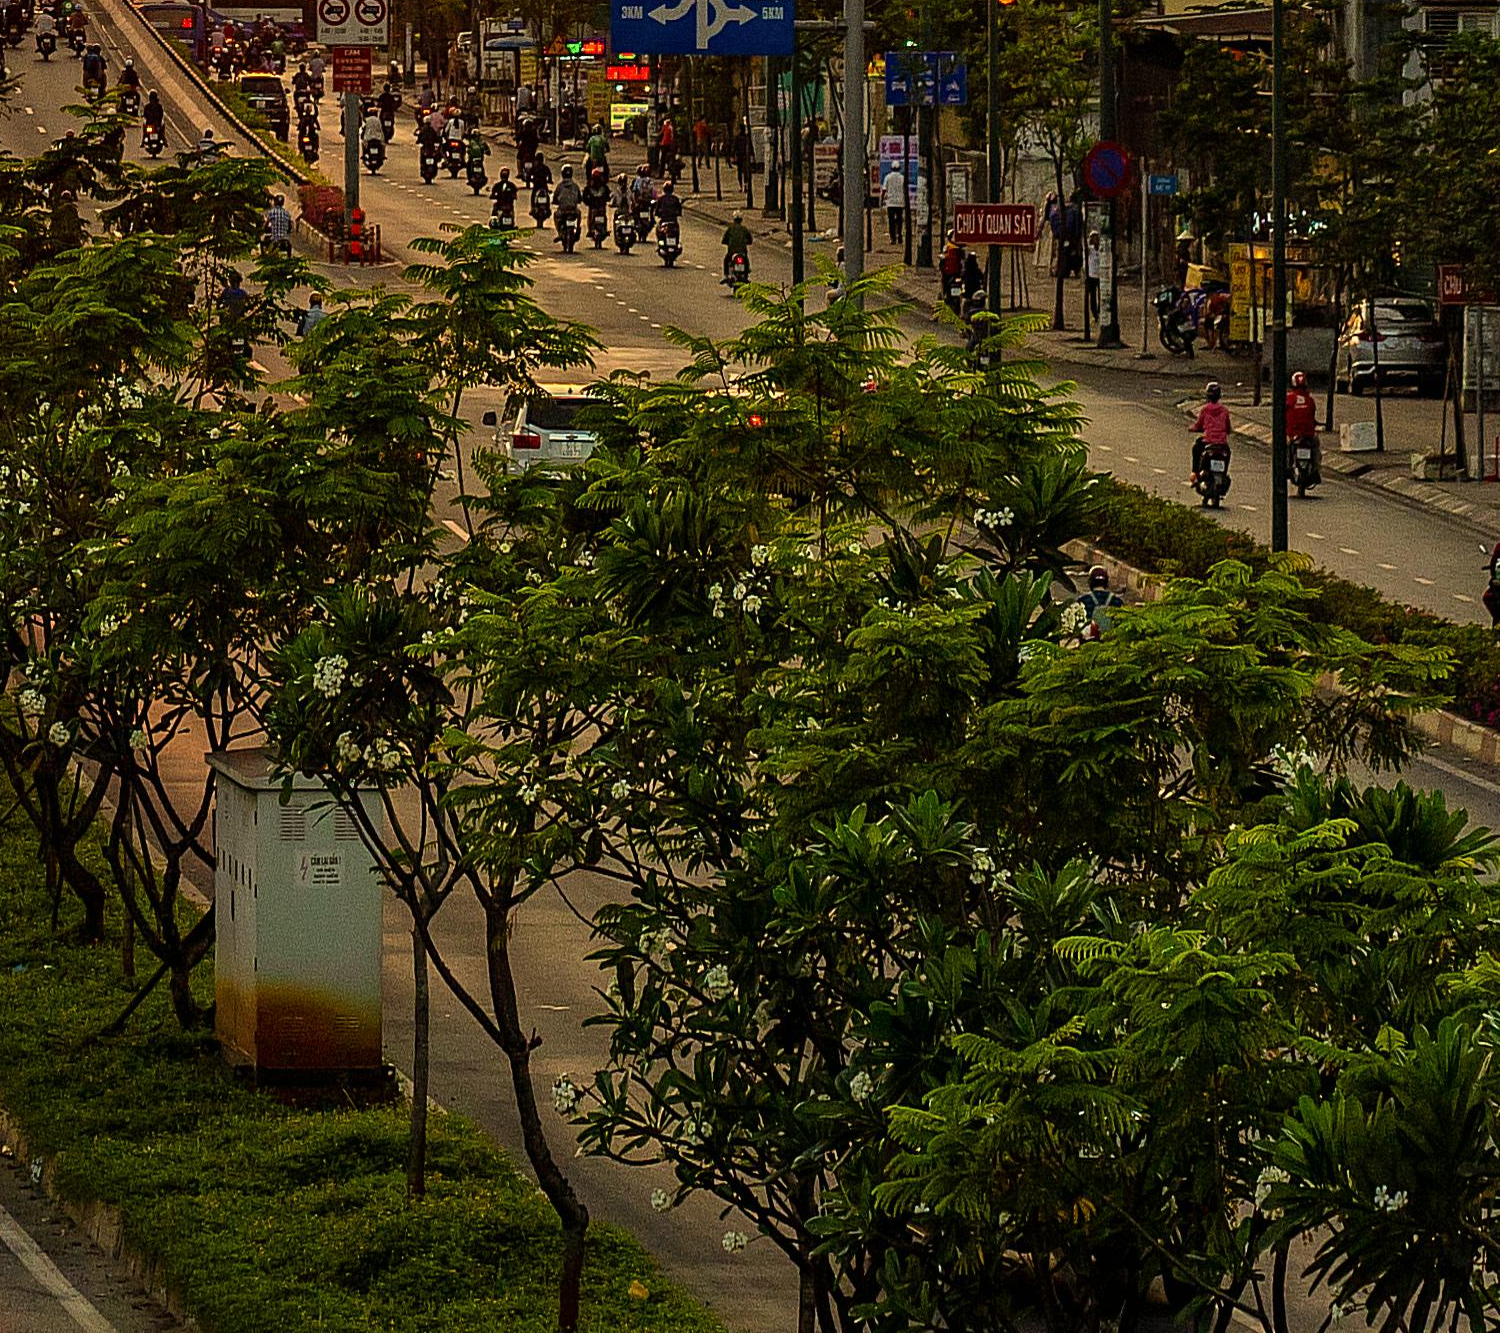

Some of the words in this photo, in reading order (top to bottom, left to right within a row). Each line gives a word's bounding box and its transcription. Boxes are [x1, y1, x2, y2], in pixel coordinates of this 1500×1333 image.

[621, 6, 643, 19] 3KM
[957, 208, 975, 235] CHÚ
[977, 209, 985, 235] Ý
[986, 214, 1012, 235] QUAN
[1014, 209, 1032, 236] SÁT
